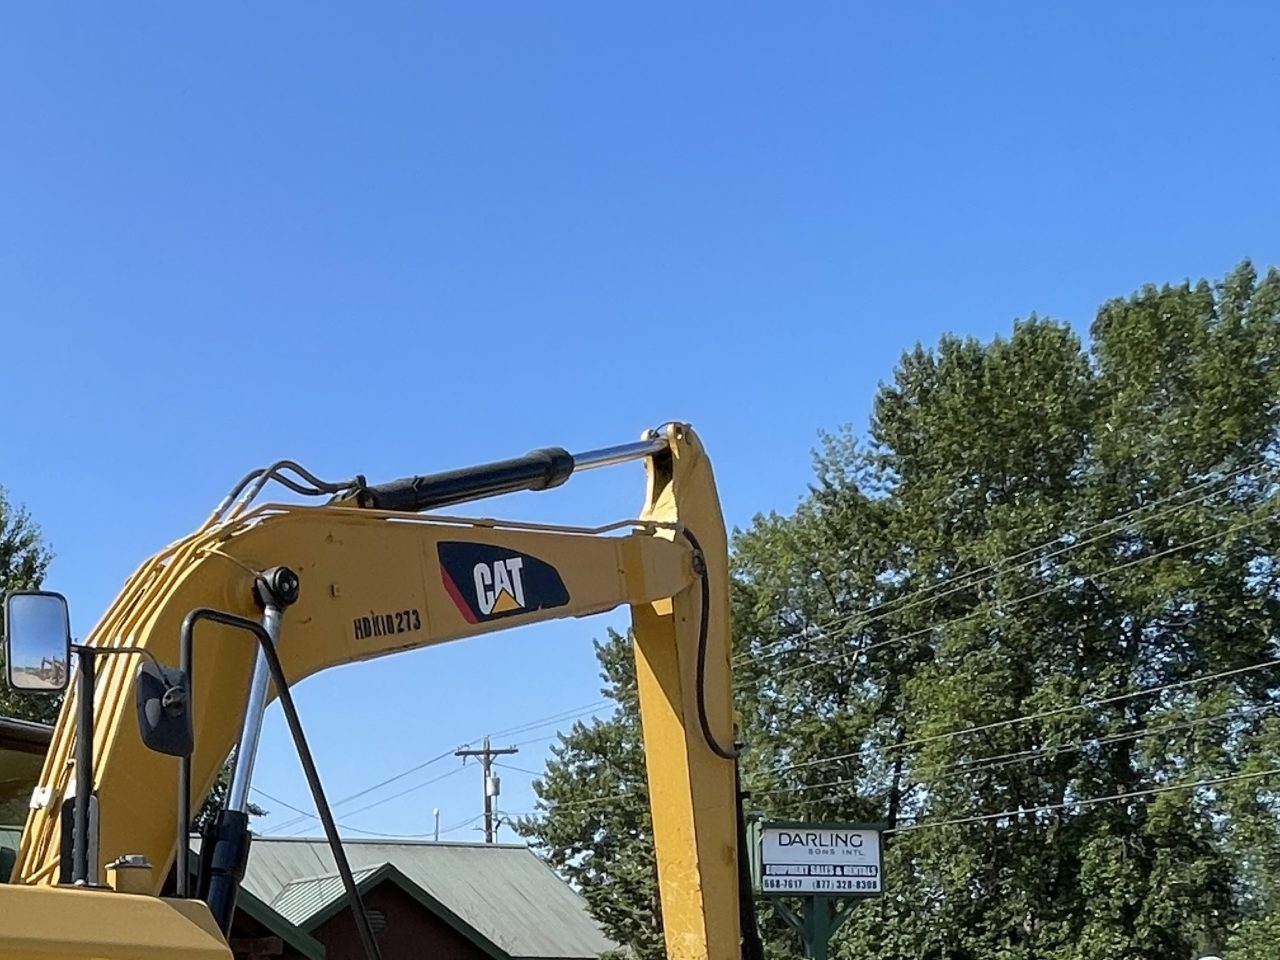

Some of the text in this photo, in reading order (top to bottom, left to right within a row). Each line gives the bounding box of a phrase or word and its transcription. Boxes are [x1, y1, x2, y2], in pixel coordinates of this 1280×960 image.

[473, 556, 526, 616] CAT
[778, 832, 864, 848] DARLING
[808, 848, 836, 856] SONS
[810, 865, 835, 875] SALES
